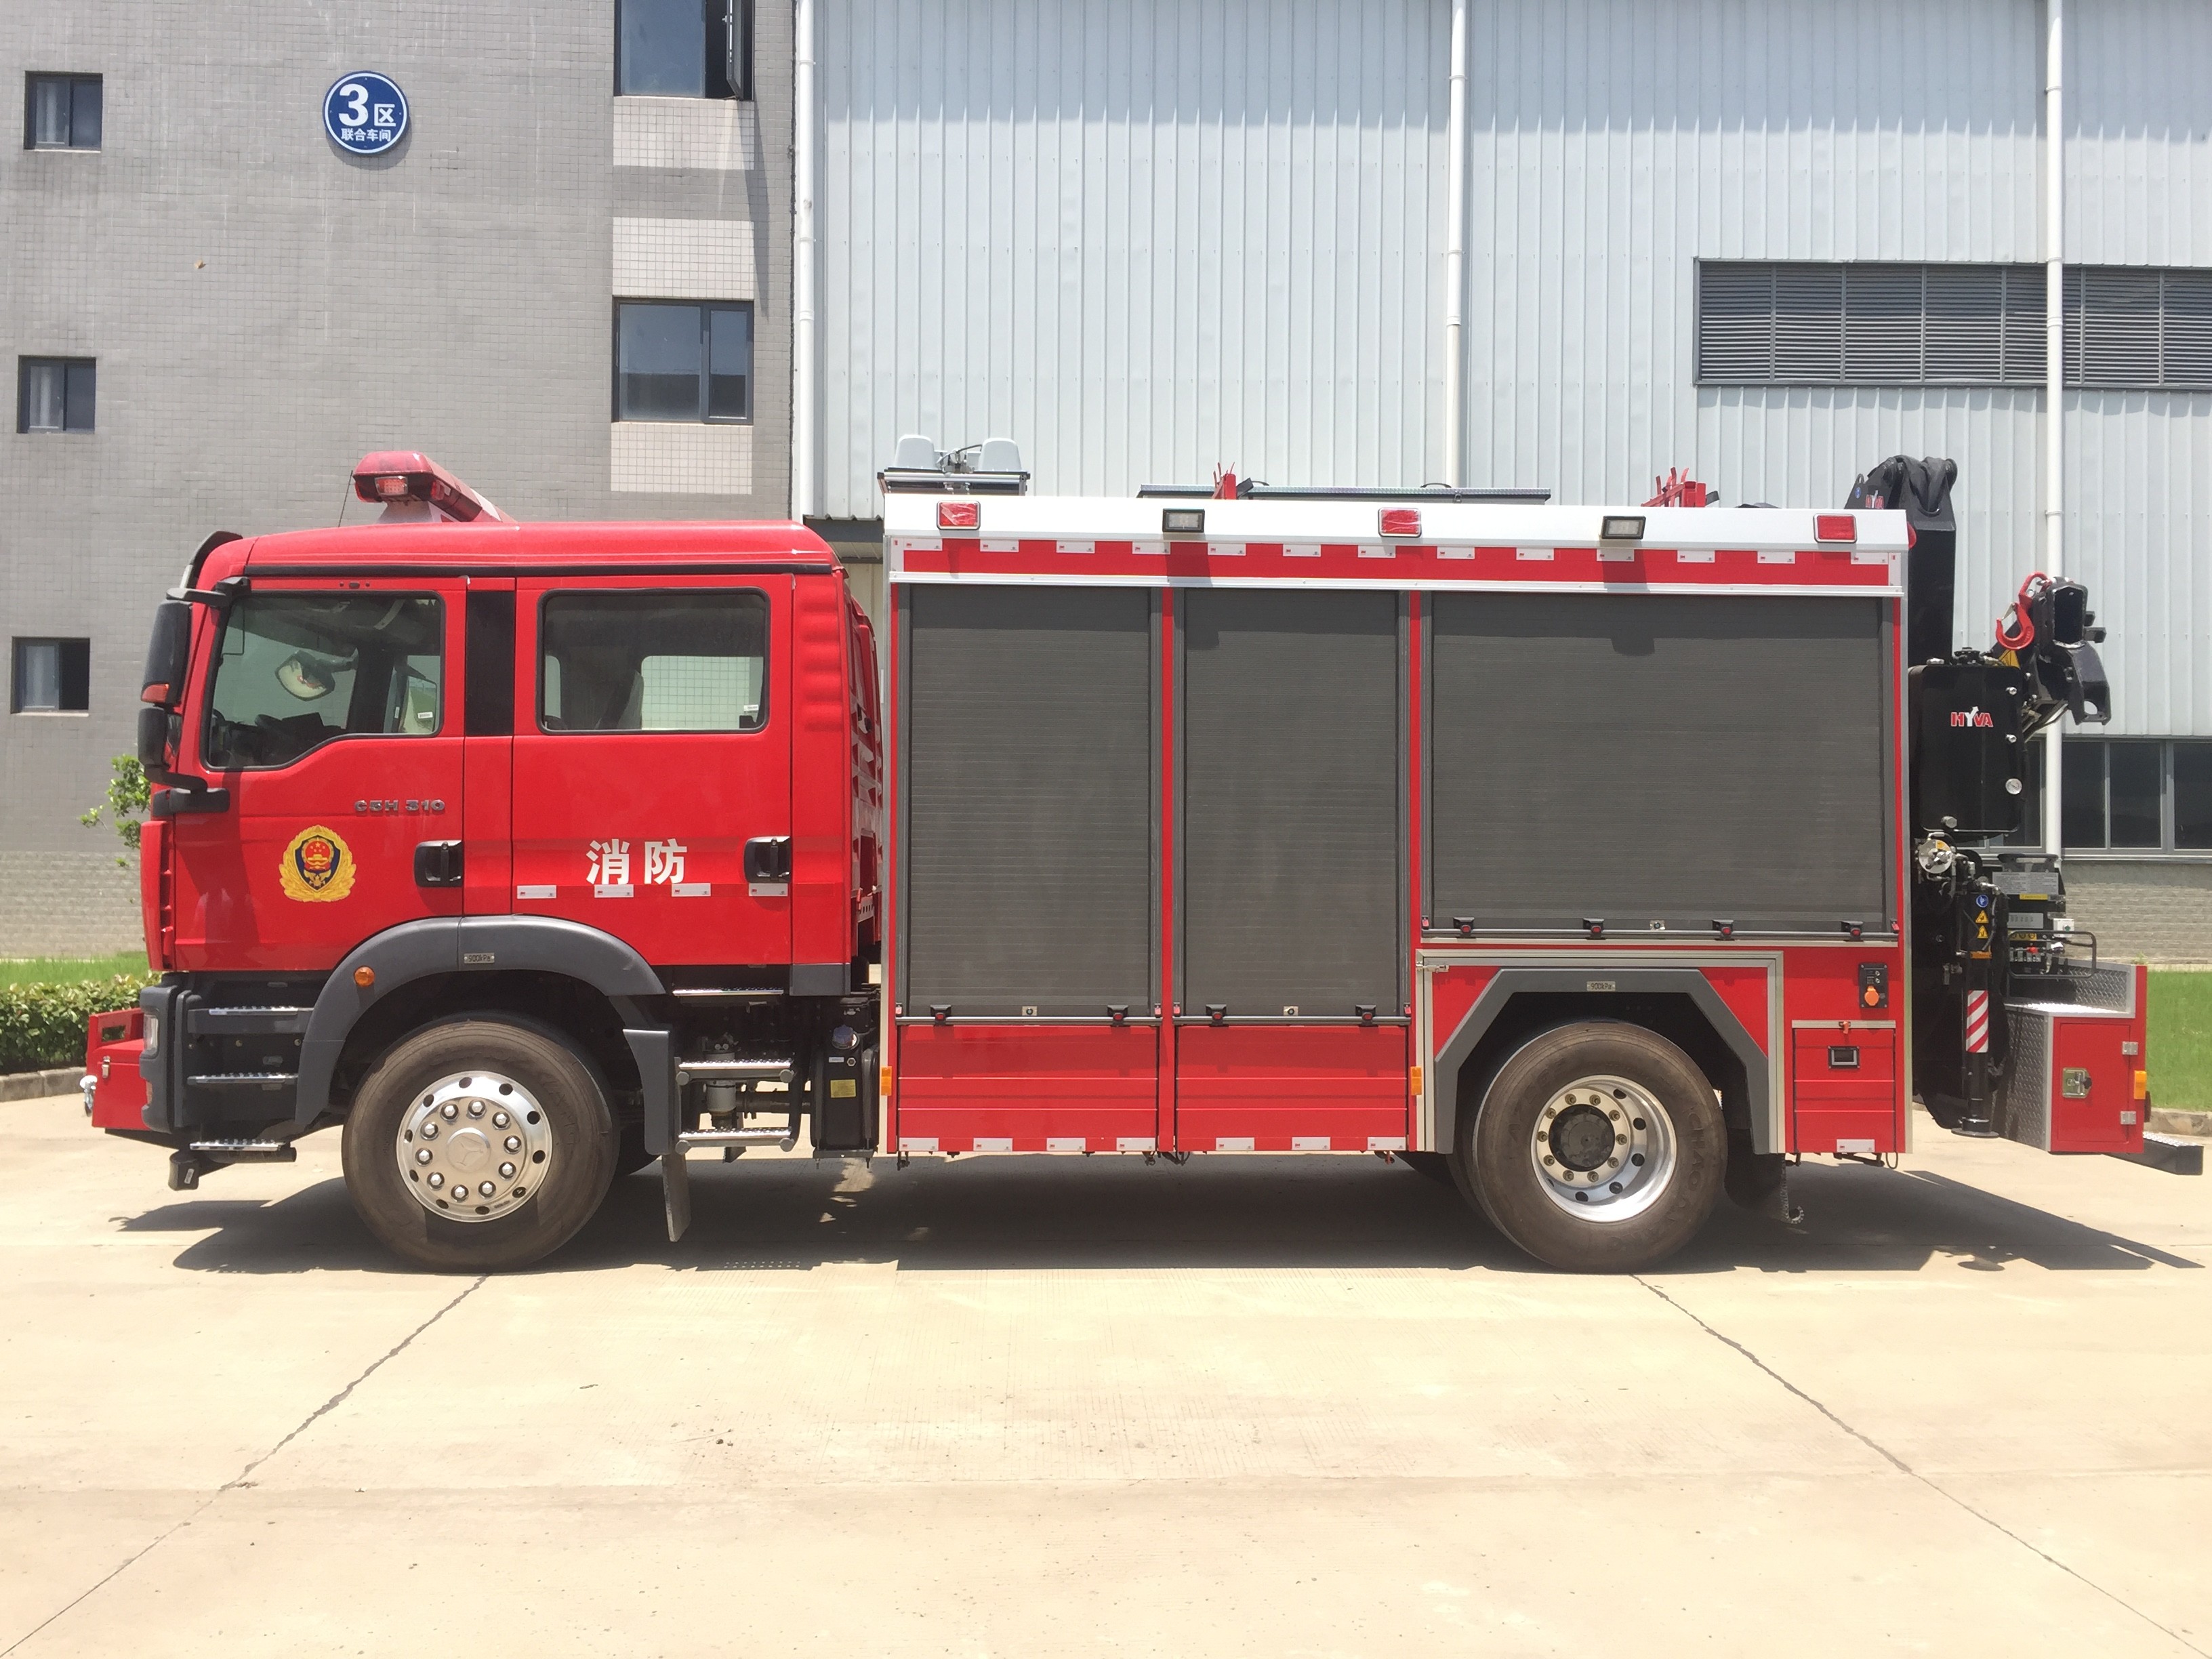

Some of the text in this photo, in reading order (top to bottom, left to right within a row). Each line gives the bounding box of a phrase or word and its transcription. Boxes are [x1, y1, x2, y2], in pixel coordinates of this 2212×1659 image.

[339, 83, 396, 127] 3区
[341, 128, 391, 142] 联合车间
[1950, 706, 1994, 727] HYVA
[405, 799, 445, 811] 310
[586, 838, 687, 885] 消防
